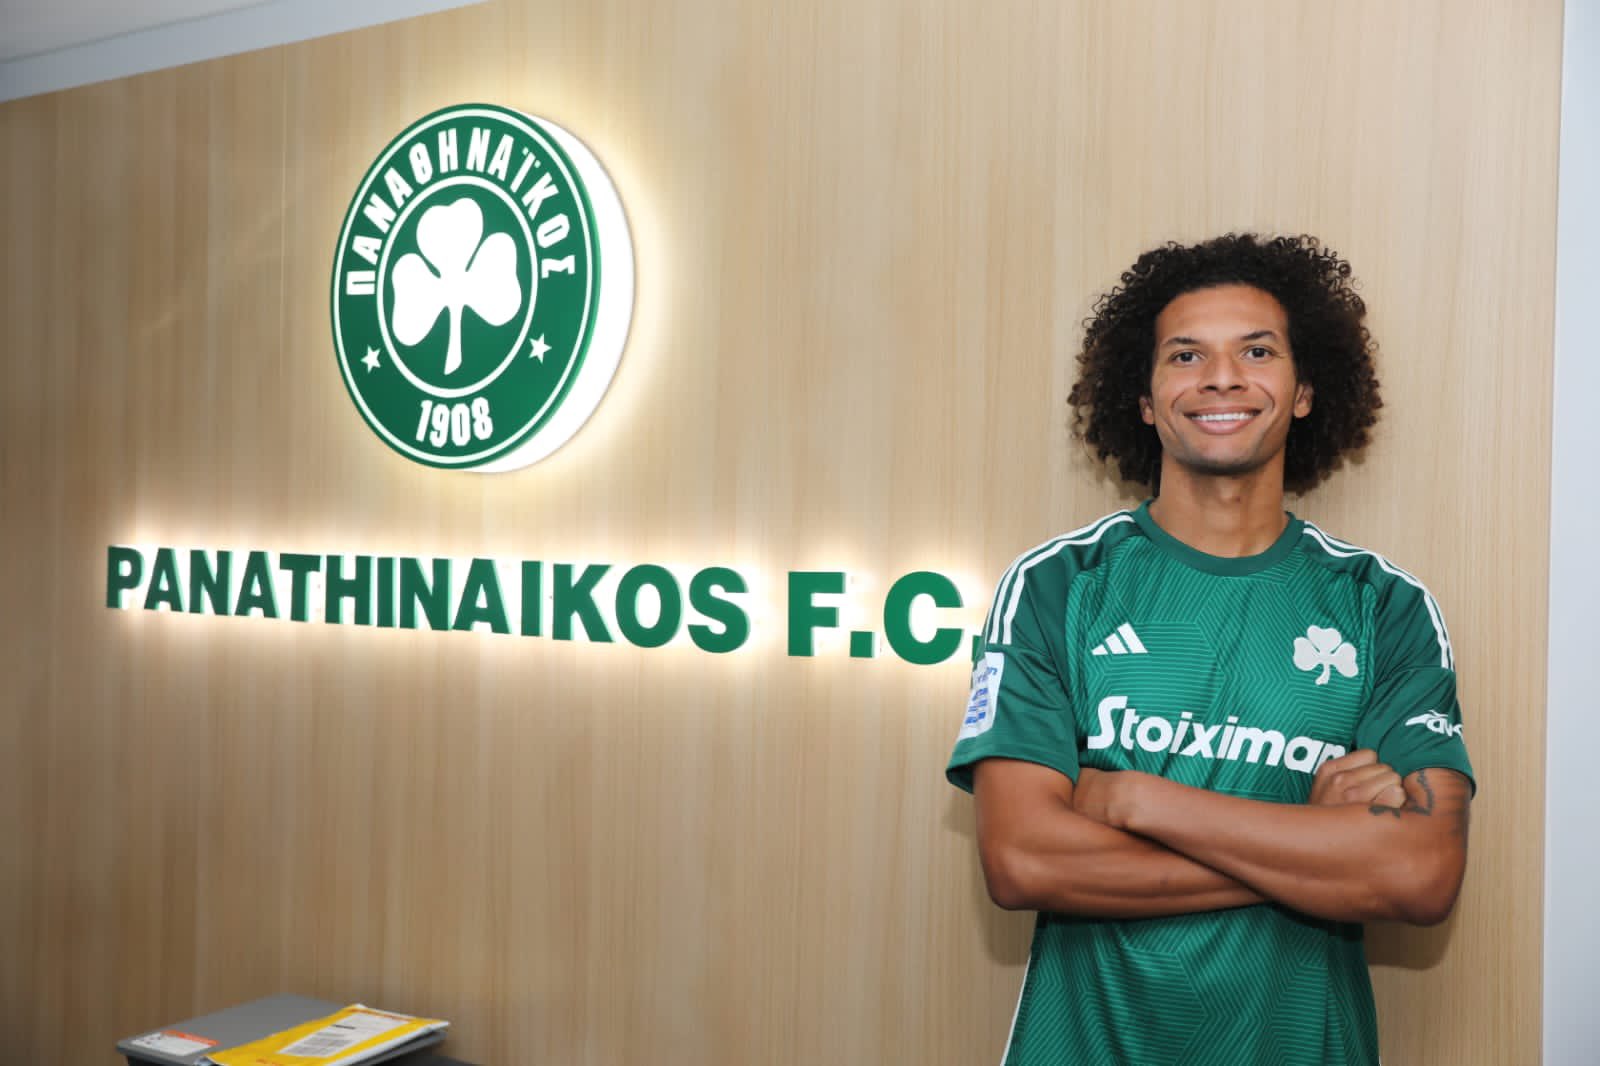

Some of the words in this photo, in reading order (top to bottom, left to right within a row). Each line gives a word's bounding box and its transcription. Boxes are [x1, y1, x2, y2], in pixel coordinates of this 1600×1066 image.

[346, 127, 576, 295] ΠΑΝΑΘΗΝΑΪΚΟΣ
[416, 397, 494, 449] 1908
[106, 545, 751, 654] PANATHINAIKOS
[787, 571, 982, 665] F.C
